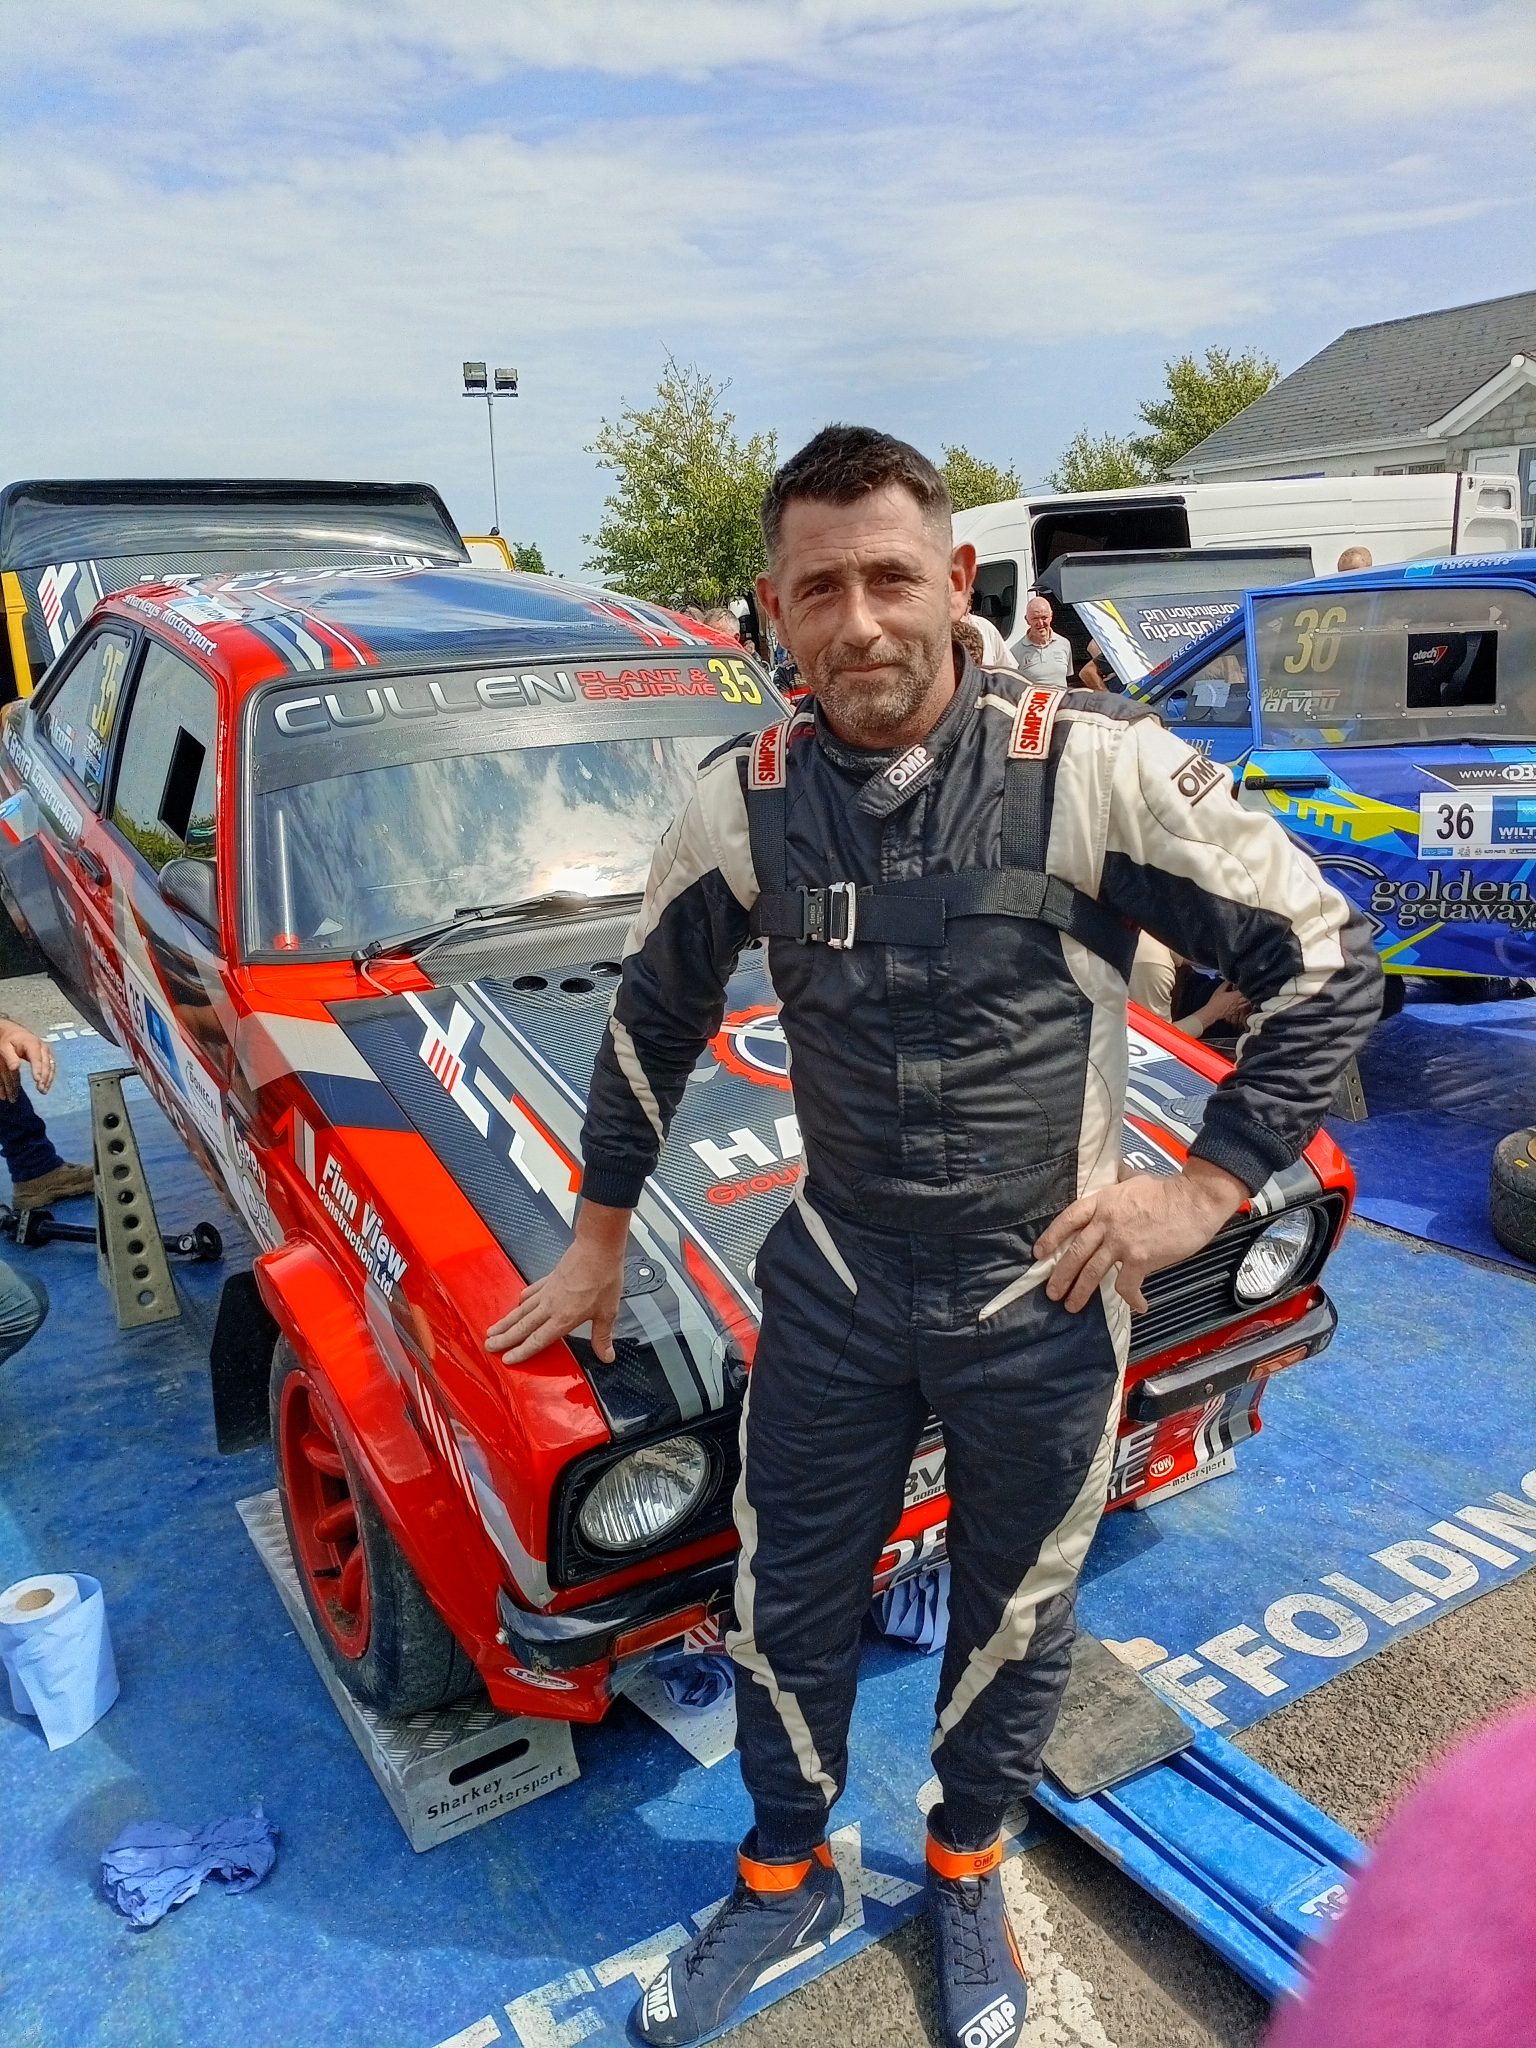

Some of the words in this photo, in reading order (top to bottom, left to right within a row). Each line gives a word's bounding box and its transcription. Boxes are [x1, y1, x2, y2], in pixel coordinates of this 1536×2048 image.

[122, 594, 162, 618] Sharkeys
[160, 609, 218, 656] Motorsport
[1171, 615, 1232, 662] RECYCLING
[1284, 606, 1348, 674] 36
[576, 669, 681, 685] PLANT
[689, 668, 709, 682] &
[708, 659, 763, 706] 35
[273, 671, 575, 738] CULLEN
[1019, 692, 1051, 751] SIMPSON
[758, 726, 780, 783] SIMPSON
[889, 746, 927, 786] OMP
[1177, 757, 1217, 798] OMP
[31, 765, 79, 840] Construction
[1436, 803, 1475, 840] 36
[1370, 869, 1531, 912] golden
[1398, 900, 1536, 928] getaway
[189, 1070, 219, 1118] DONEGAL
[322, 1153, 359, 1220] Finn
[361, 1202, 408, 1283] View
[318, 1182, 374, 1273] Construction
[373, 1263, 395, 1302] Ltd.
[1151, 1455, 1173, 1475] TOW
[1172, 1457, 1226, 1487] motorsport
[427, 1776, 503, 1820] Sharkey
[476, 1765, 564, 1816] motorsport
[973, 1853, 994, 1868] OMP
[646, 1971, 673, 2023] OMP
[964, 2001, 1017, 2048] OMP
